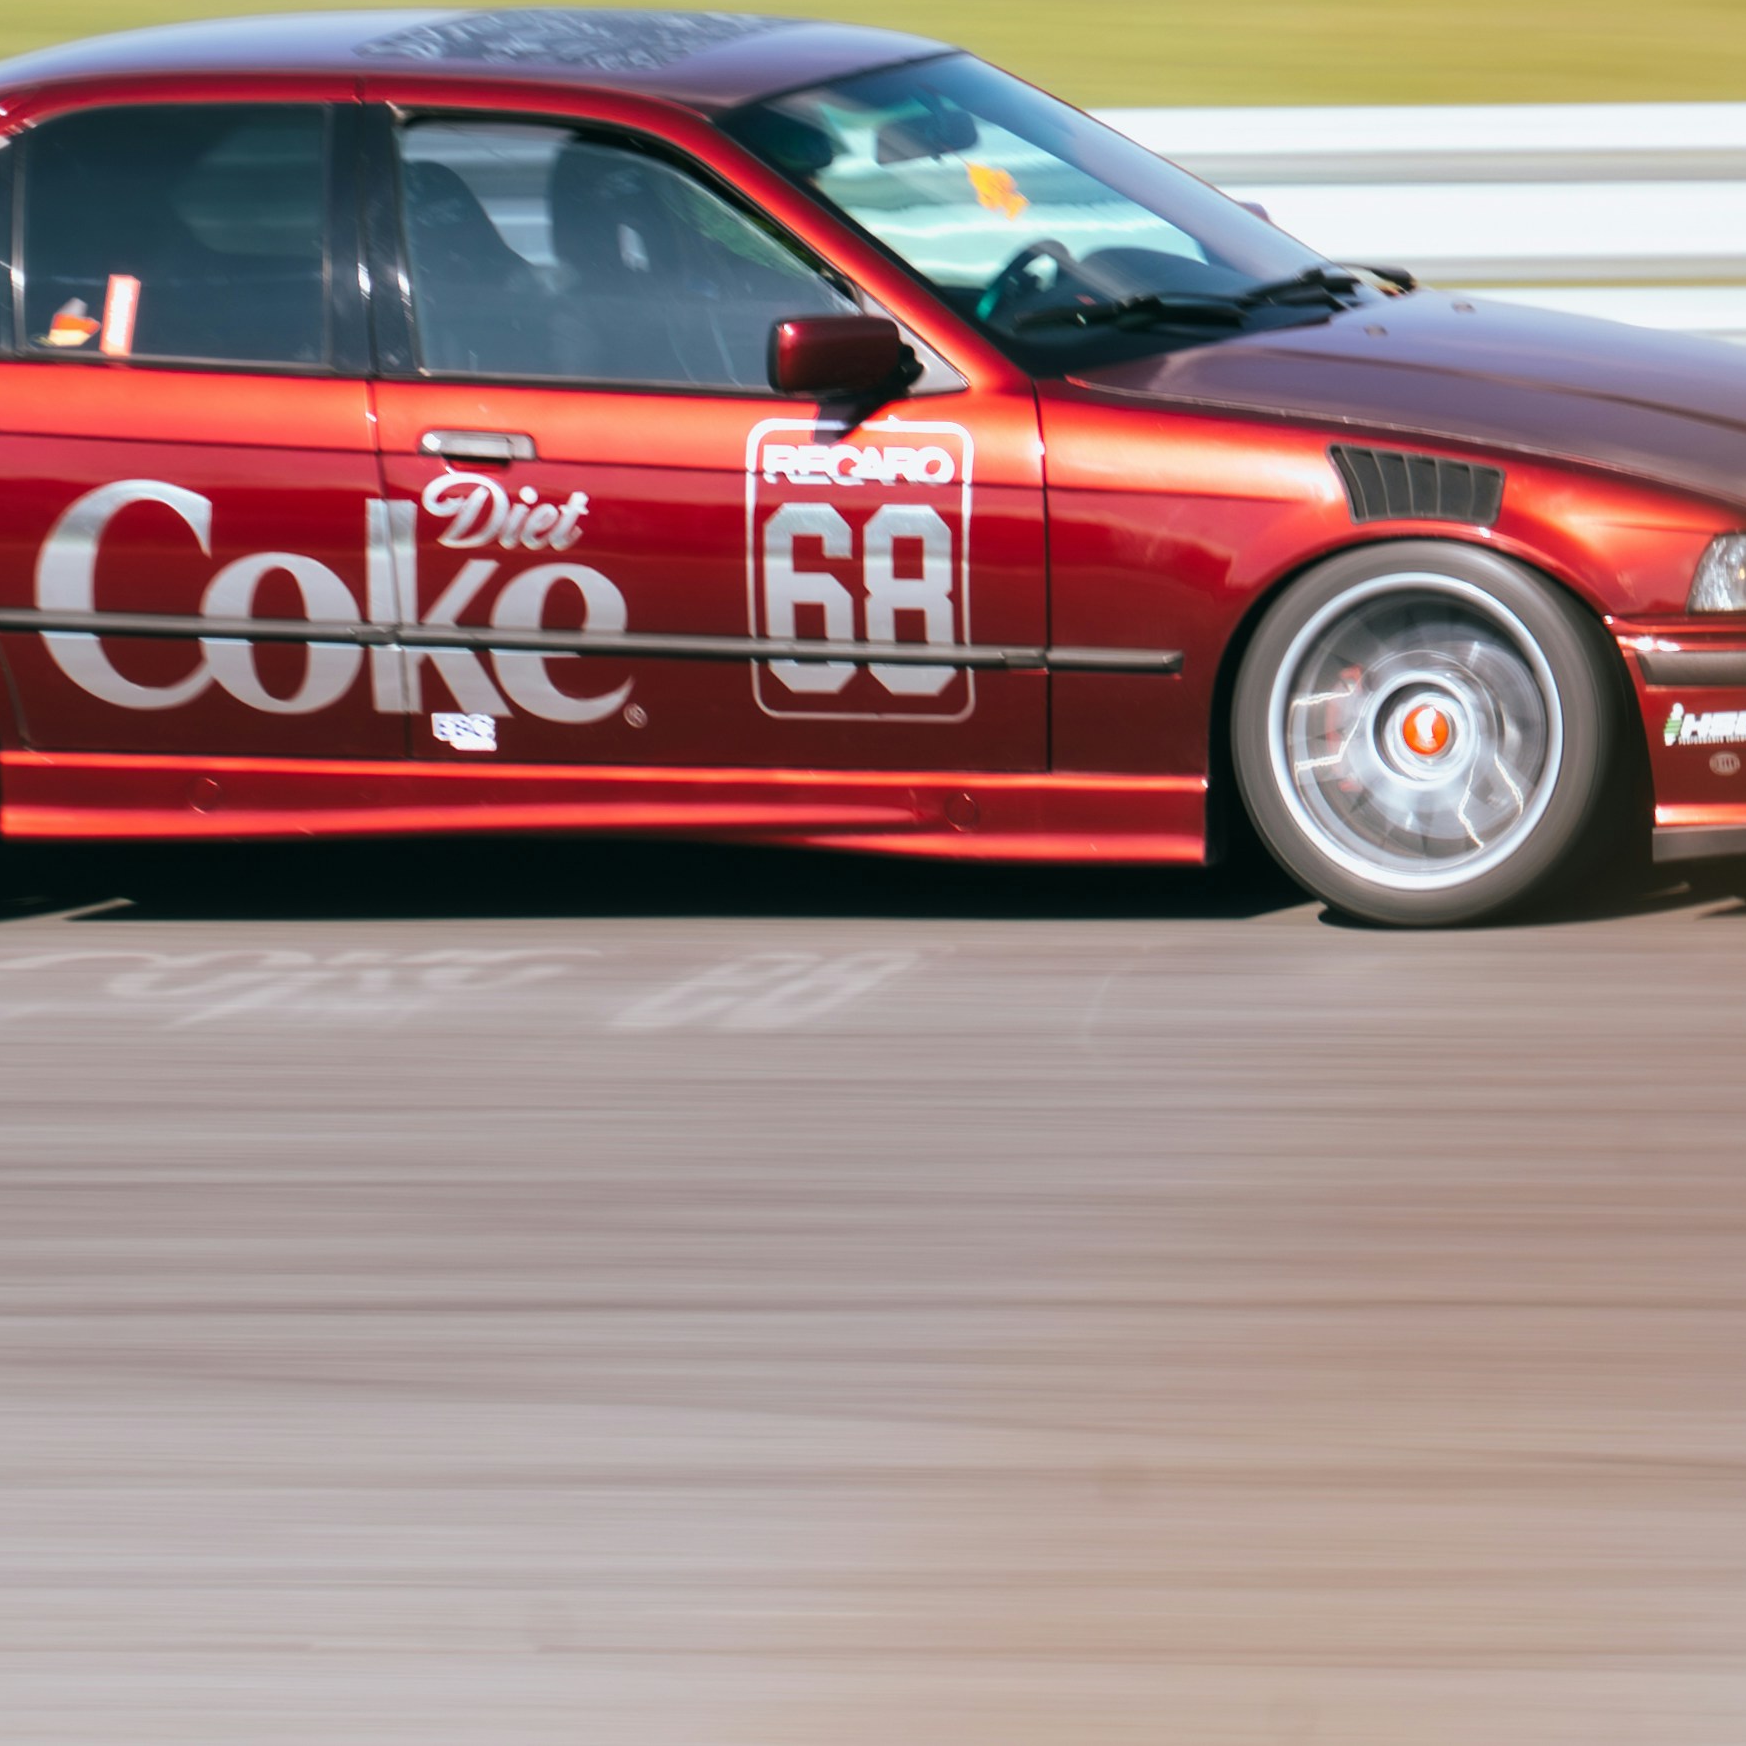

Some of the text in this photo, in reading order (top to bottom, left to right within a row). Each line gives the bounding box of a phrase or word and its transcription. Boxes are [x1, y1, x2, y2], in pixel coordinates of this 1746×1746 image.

[422, 470, 590, 552] Diet
[762, 443, 956, 486] RECARO
[34, 478, 636, 725] Coke
[763, 501, 958, 697] 68
